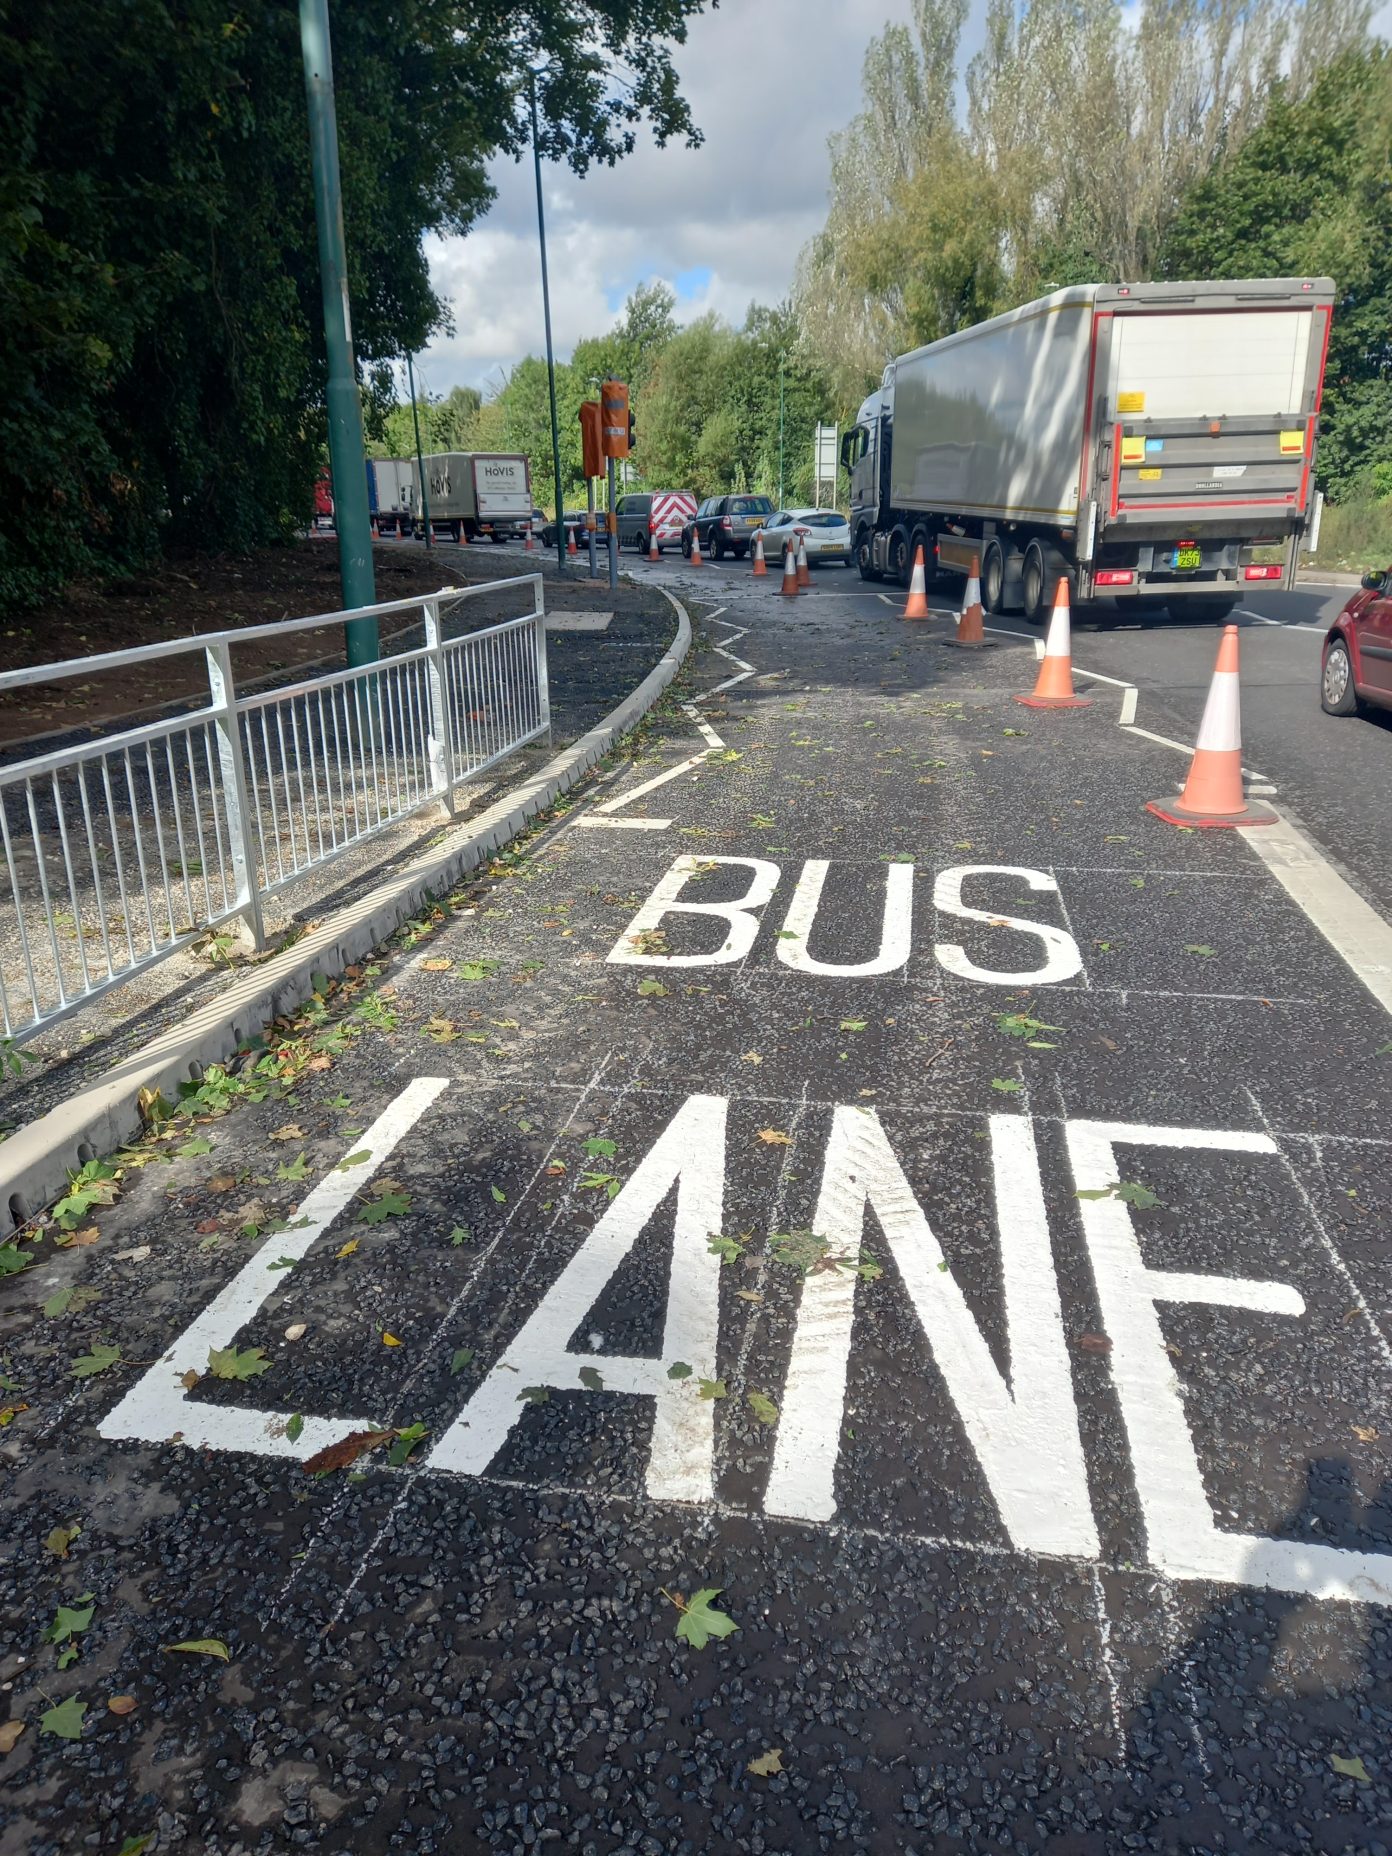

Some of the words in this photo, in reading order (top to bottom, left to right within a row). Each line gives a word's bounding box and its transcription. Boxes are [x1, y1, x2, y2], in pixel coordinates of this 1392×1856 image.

[485, 466, 515, 476] HOVIS
[605, 854, 1084, 986] BUS
[98, 1076, 1392, 1608] LANE
